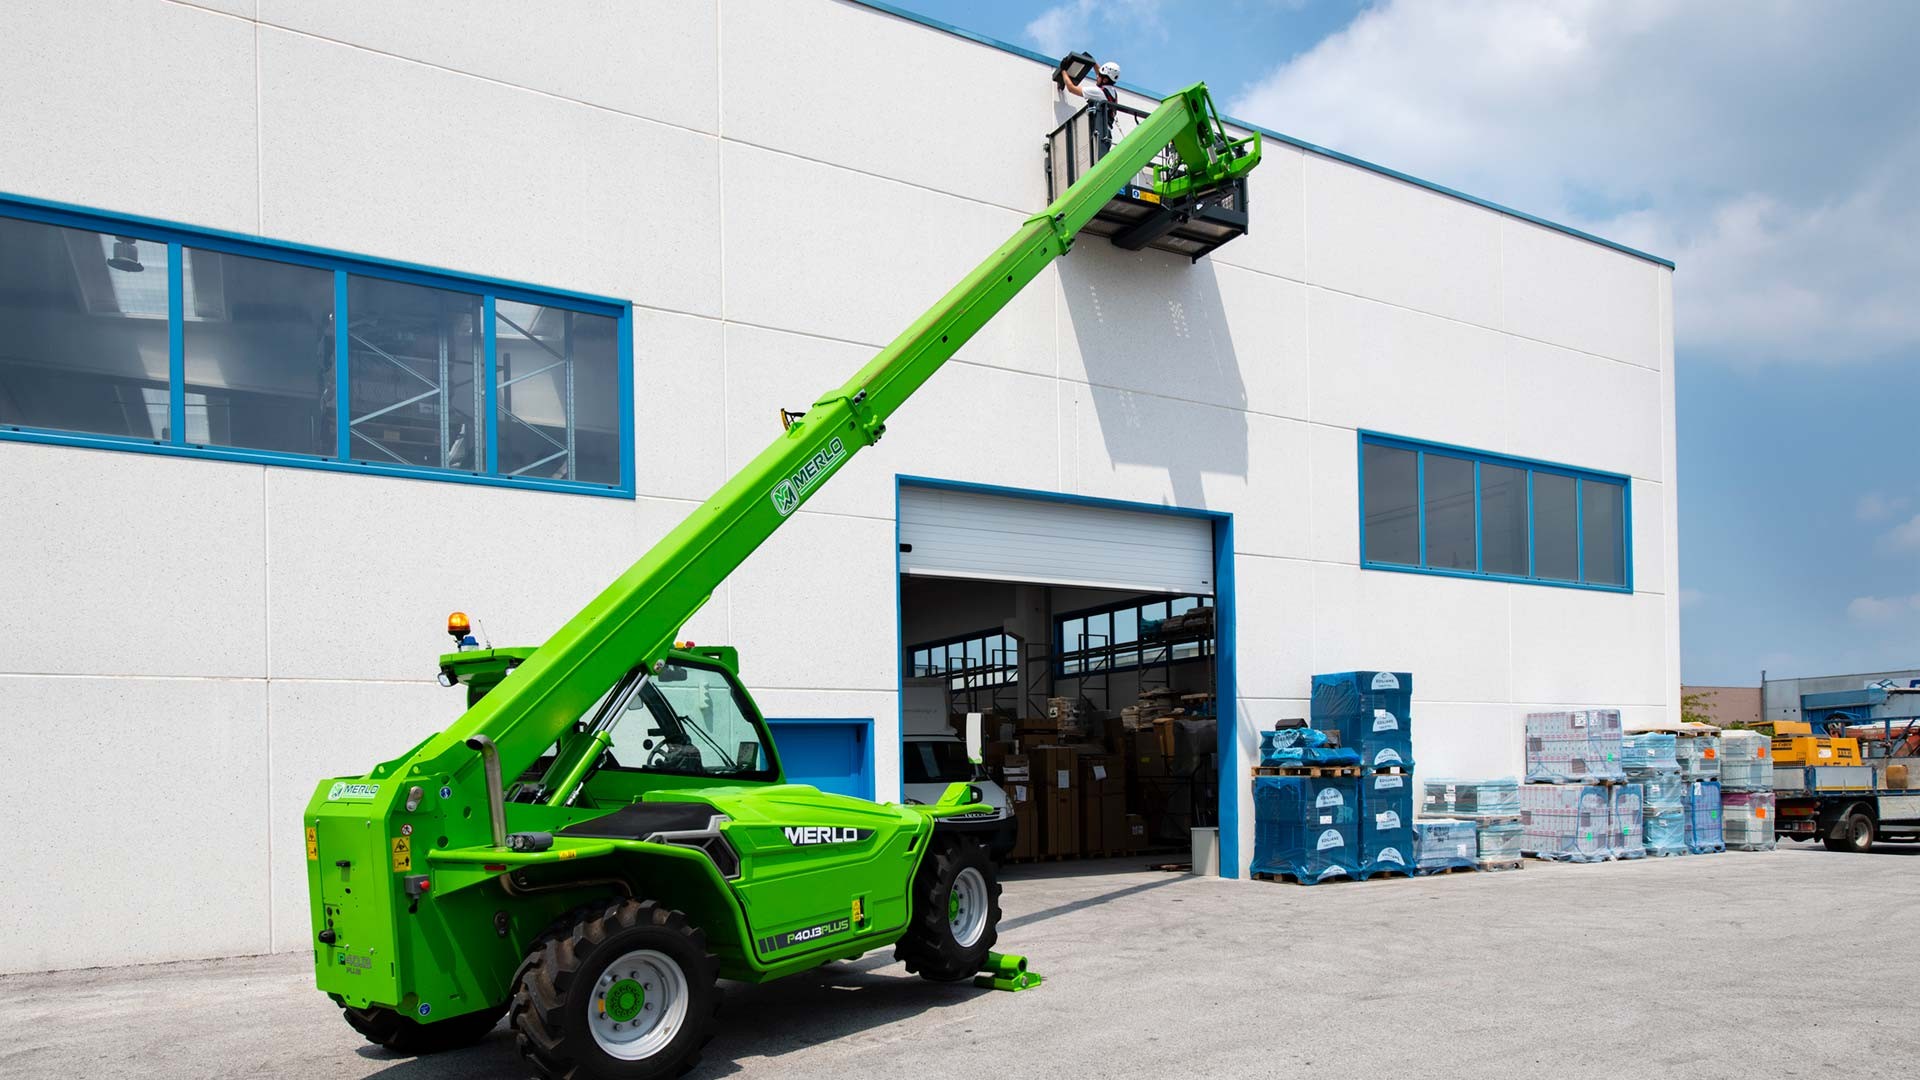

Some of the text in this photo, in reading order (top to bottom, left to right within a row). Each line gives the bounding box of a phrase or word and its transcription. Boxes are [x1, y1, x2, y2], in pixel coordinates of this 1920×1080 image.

[792, 437, 843, 490] MERLO
[345, 785, 379, 794] MERLO
[784, 826, 858, 845] MERLO
